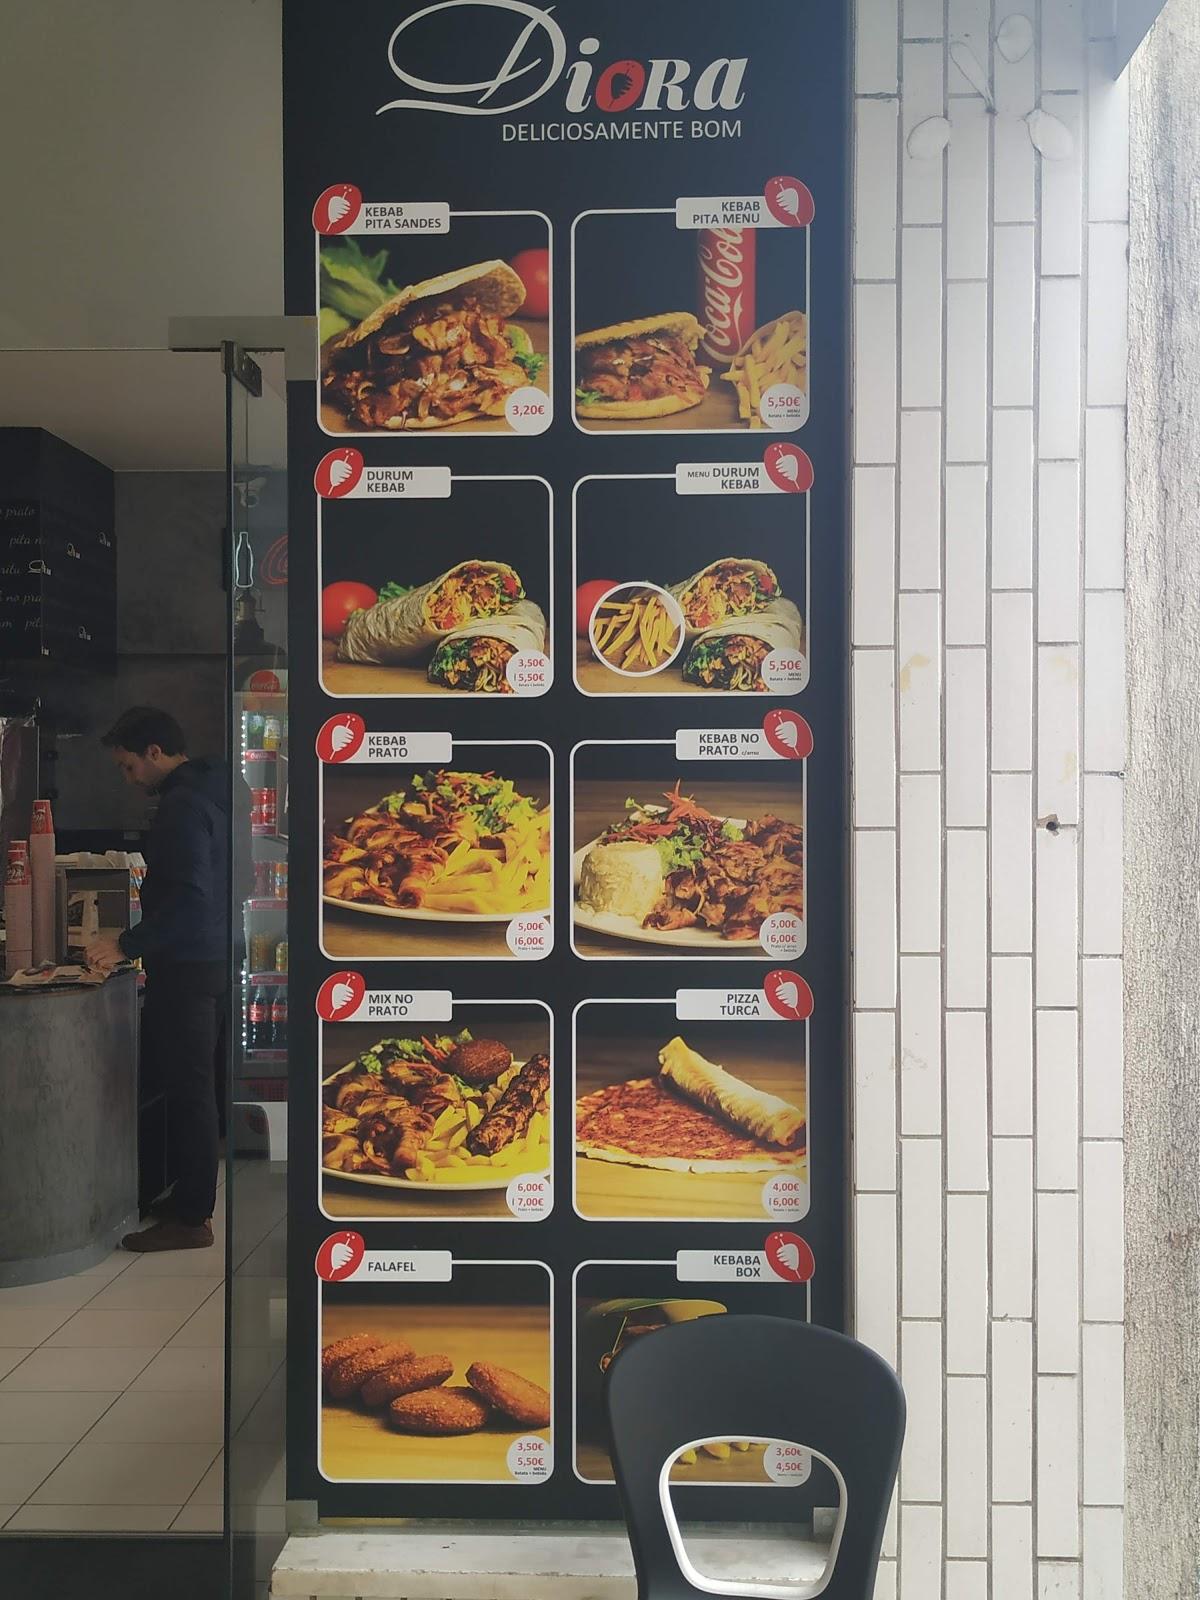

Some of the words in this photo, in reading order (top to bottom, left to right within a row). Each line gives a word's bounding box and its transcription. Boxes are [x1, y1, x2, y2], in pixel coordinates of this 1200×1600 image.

[502, 121, 684, 142] DELICIOSAMENTE
[690, 119, 742, 139] BOM
[365, 206, 404, 217] KEBAB
[721, 201, 761, 212] KEBAB
[365, 219, 391, 229] PITA
[394, 217, 442, 229] SANDES
[692, 214, 719, 224] PITA
[722, 213, 761, 224] MENU
[700, 227, 744, 364] Coca-Col
[767, 396, 801, 409] 5,50€
[512, 405, 545, 417] 3,20€
[366, 471, 414, 481] DURUM
[712, 467, 760, 478] DURUM
[366, 482, 406, 493] KEBAB
[720, 479, 760, 490] KEBAB
[518, 658, 545, 668] 3,50€
[769, 660, 802, 671] 5,50€
[368, 736, 407, 746] KEBAB
[698, 733, 738, 744] KEBAB
[740, 733, 760, 744] NO
[368, 747, 408, 758] PRATO
[698, 745, 739, 756] PRATO
[518, 922, 544, 932] 5,00€
[770, 920, 797, 929] 5,00€
[368, 994, 392, 1004] MIX
[394, 994, 414, 1004] NO
[726, 993, 761, 1004] PIZZA
[368, 1005, 408, 1016] PRATO
[719, 1005, 761, 1016] TURCA
[517, 1183, 545, 1193] 6,00€
[772, 1182, 800, 1193] 4,00€
[713, 1255, 761, 1265] KEBABA
[367, 1261, 416, 1272] FALAFEL
[735, 1267, 761, 1278] BOX
[517, 1442, 545, 1452] 3,50€
[517, 1457, 544, 1467] 5,50€
[775, 1462, 803, 1472] 4,50€
